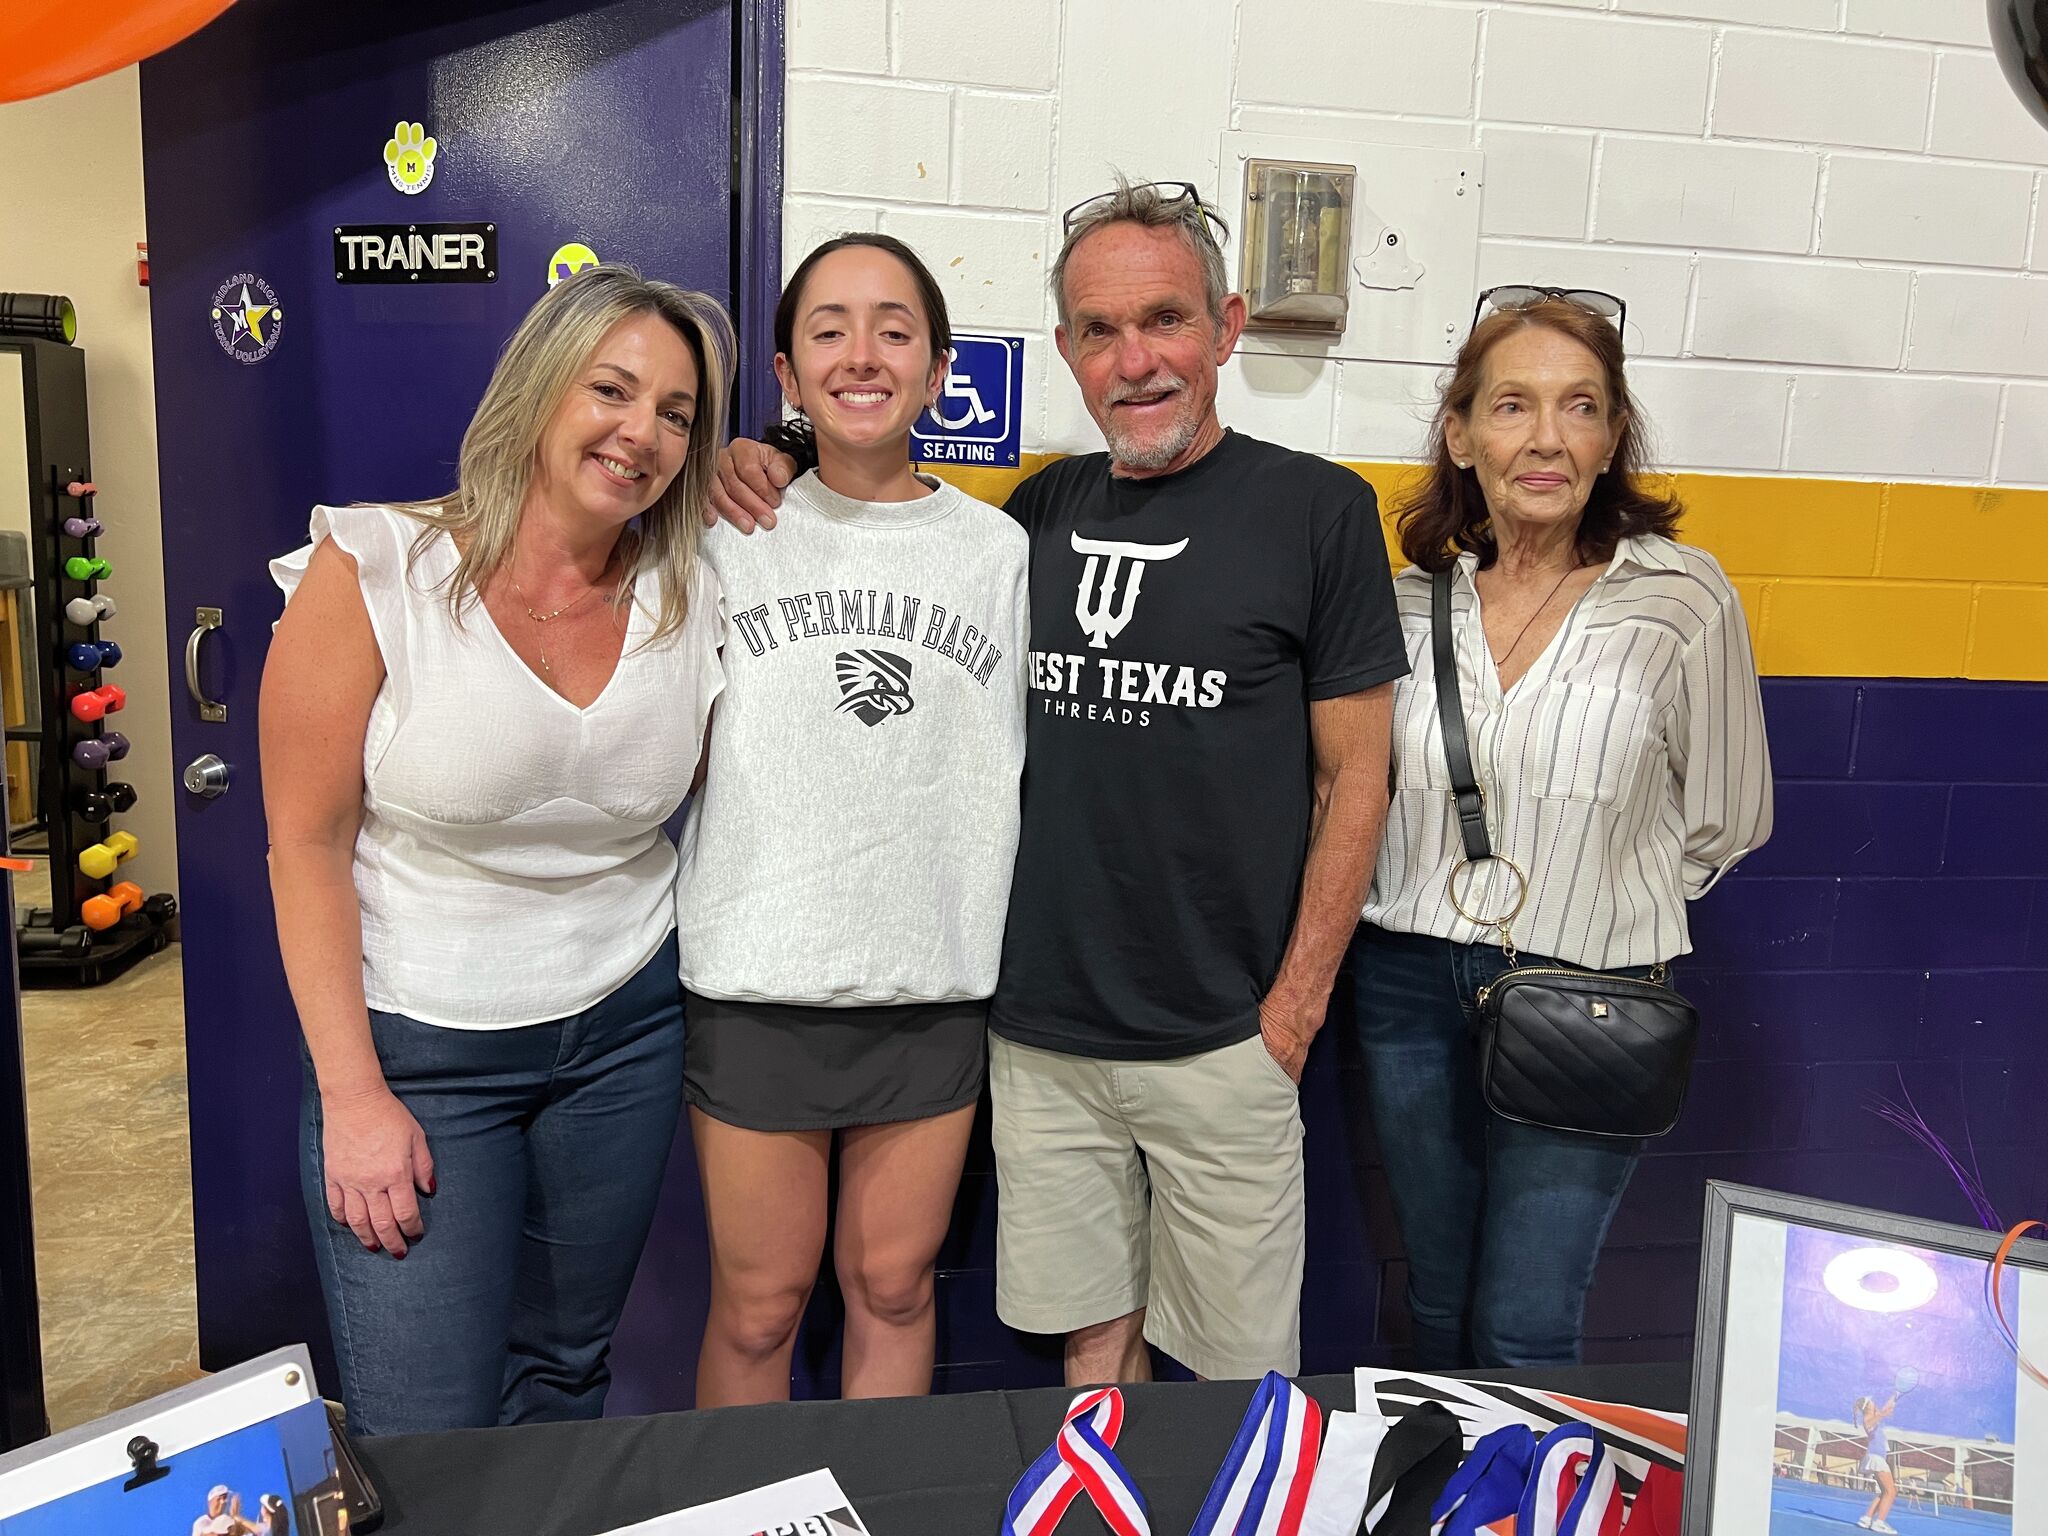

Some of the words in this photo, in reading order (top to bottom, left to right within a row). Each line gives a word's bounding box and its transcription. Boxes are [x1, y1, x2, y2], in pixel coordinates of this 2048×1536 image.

[390, 165, 404, 188] MHS
[406, 164, 432, 191] TENNIS
[406, 162, 416, 173] M
[339, 234, 486, 270] TRAINER
[213, 273, 255, 308] MIDLAND
[256, 278, 280, 308] HIGH
[231, 309, 249, 332] M
[213, 320, 236, 356] TEXAS
[235, 321, 282, 363] VOLLEYBALL
[922, 442, 995, 462] SEATING
[732, 603, 778, 658] UT
[777, 589, 921, 643] PERMIAN
[922, 603, 1003, 688] BASIN
[1098, 657, 1228, 708] TEXAS
[1044, 698, 1151, 727] THREADS
